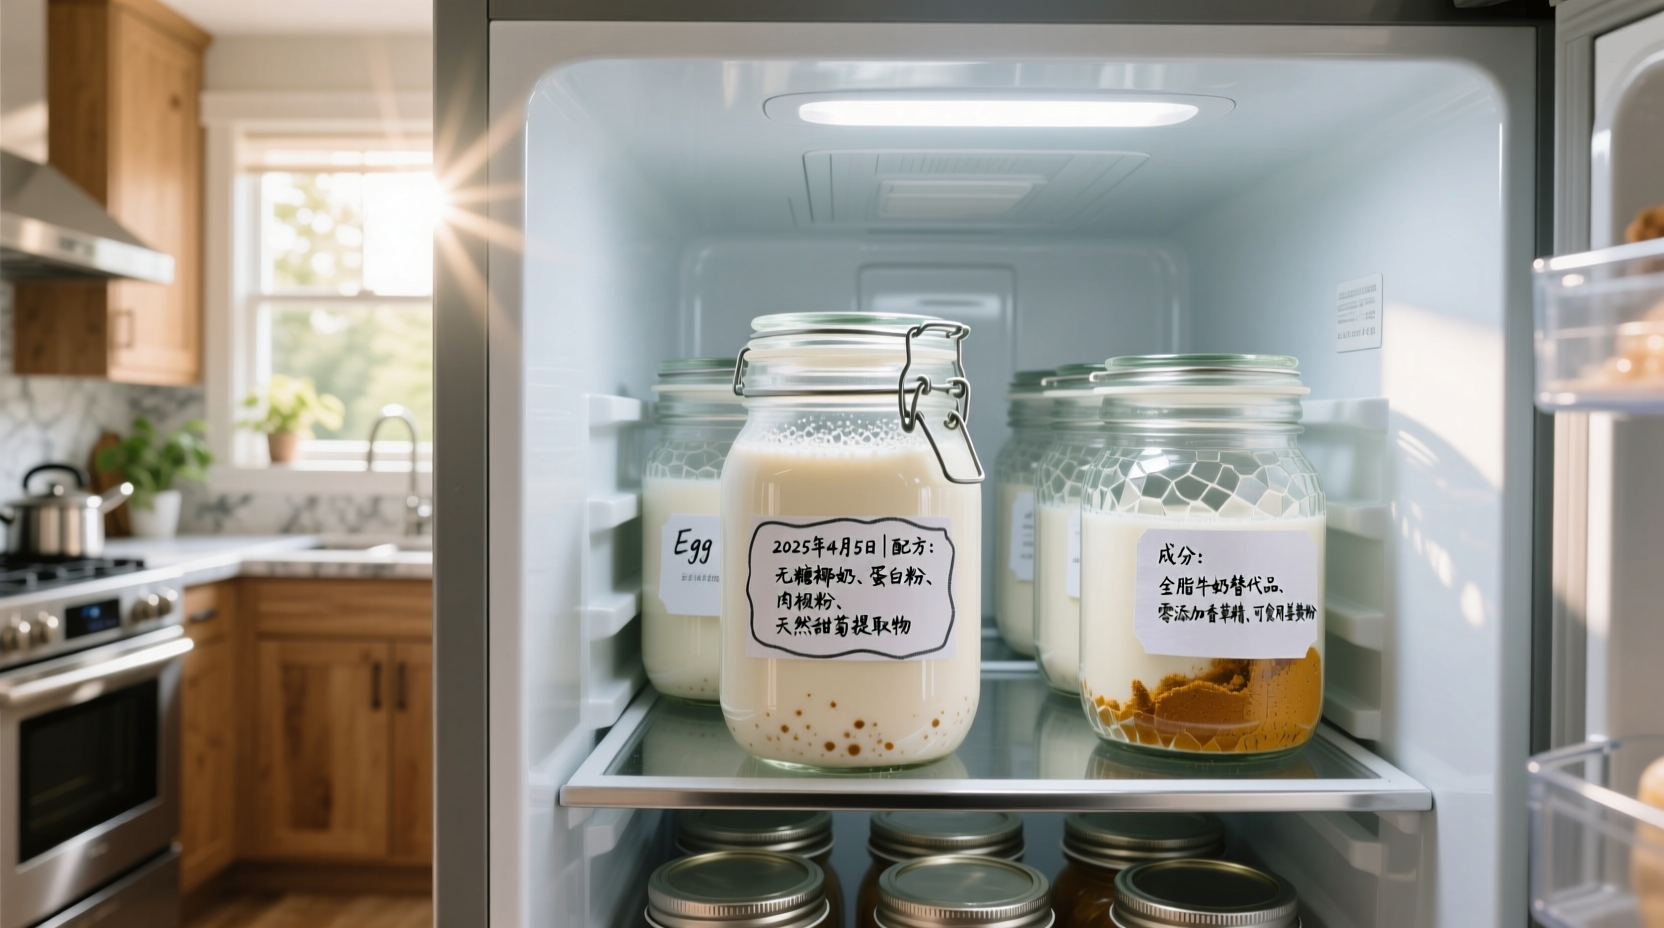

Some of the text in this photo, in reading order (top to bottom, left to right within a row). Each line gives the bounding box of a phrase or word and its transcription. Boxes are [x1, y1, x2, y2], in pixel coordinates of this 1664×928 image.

[674, 528, 713, 565] Egg
[1158, 542, 1203, 566] 成分：
[774, 564, 932, 588] 无糖椰奶、蛋白粉、
[1159, 574, 1284, 597] 全脂牛奶替代品、
